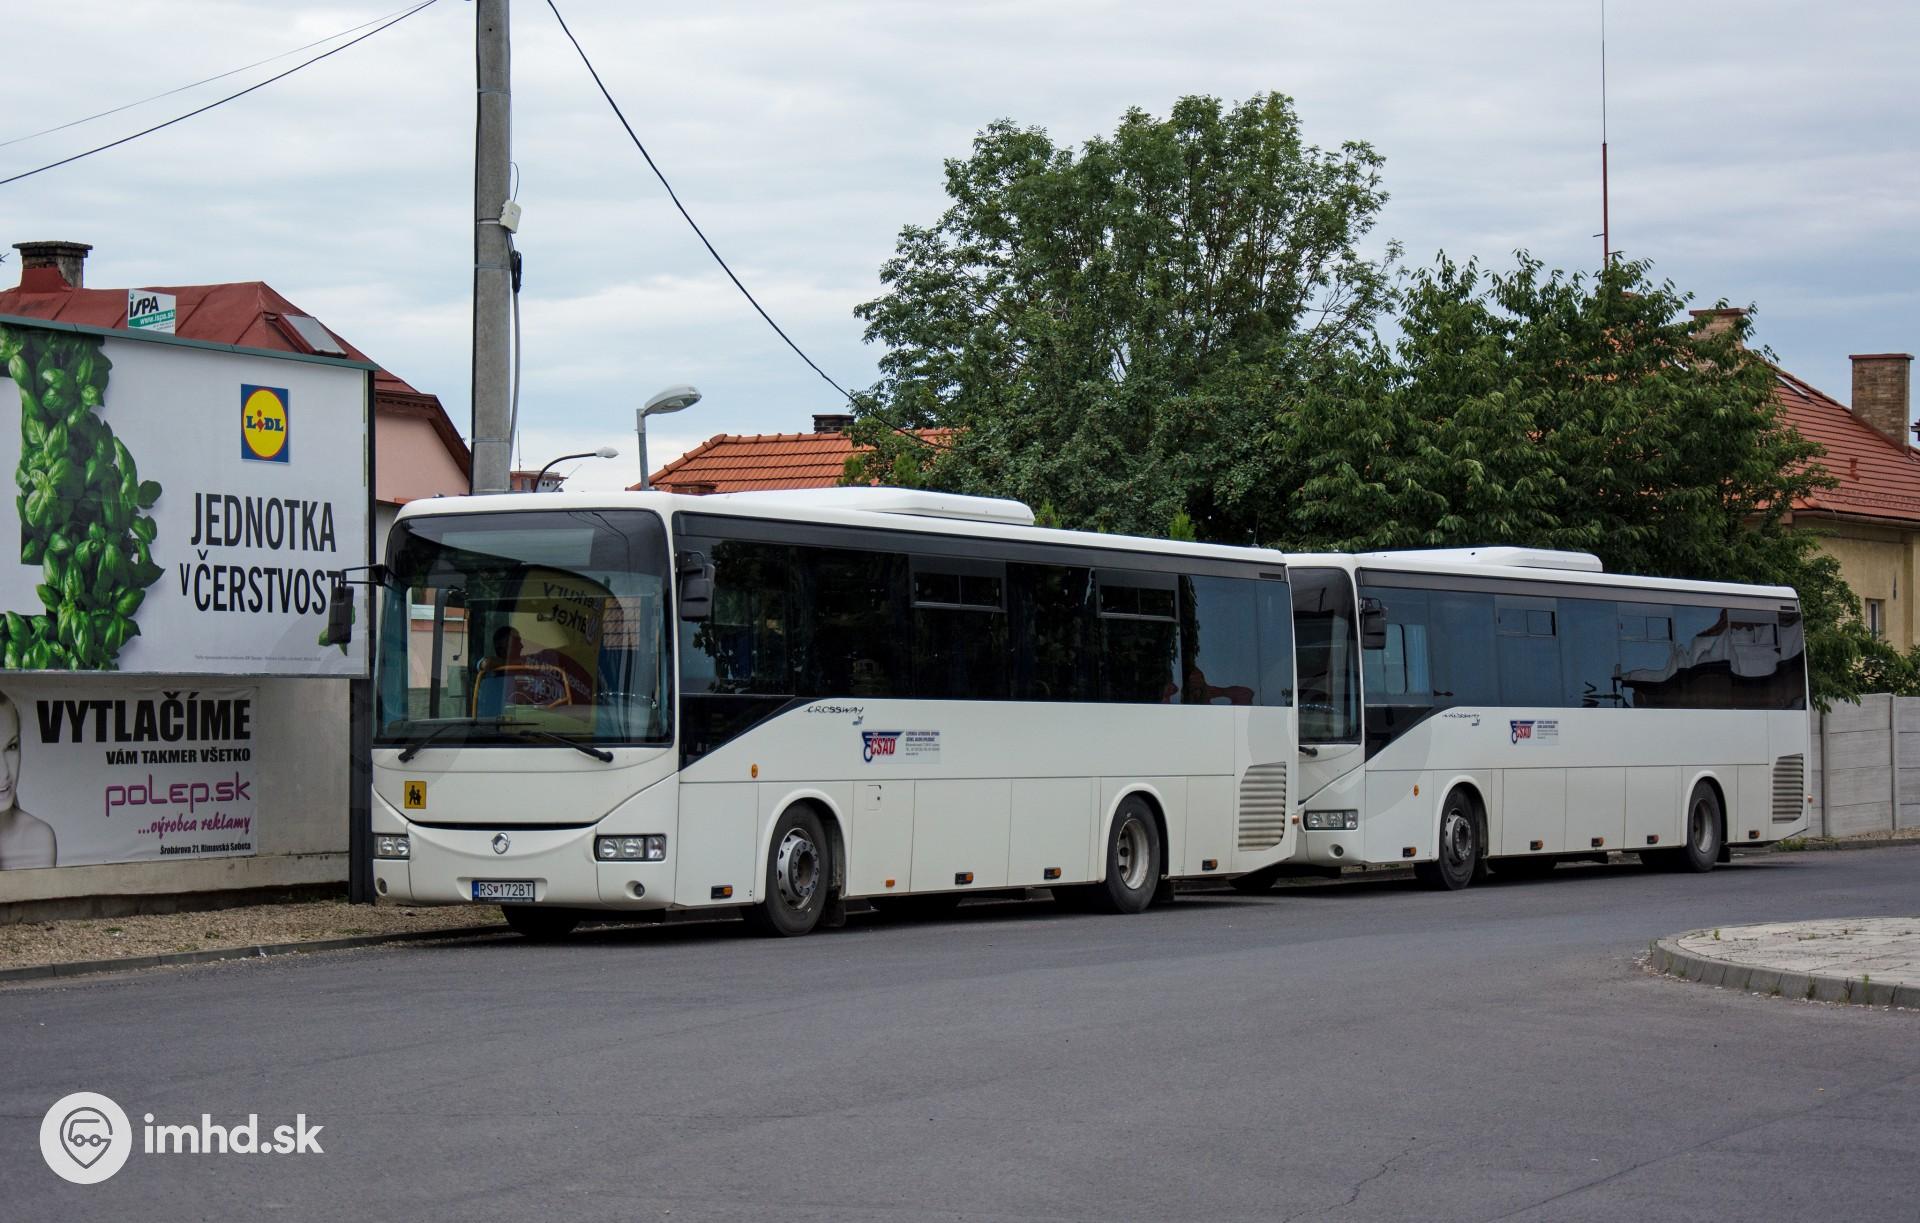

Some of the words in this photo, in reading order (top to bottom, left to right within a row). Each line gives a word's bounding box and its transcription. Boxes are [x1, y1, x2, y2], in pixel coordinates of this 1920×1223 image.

[191, 492, 337, 553] JEDNOTKA
[36, 691, 251, 744] VYTLAČÍME
[106, 749, 138, 765] VÁM
[142, 750, 197, 764] TAKMER
[201, 747, 250, 763] VŠETKO
[201, 812, 251, 834] reklamy
